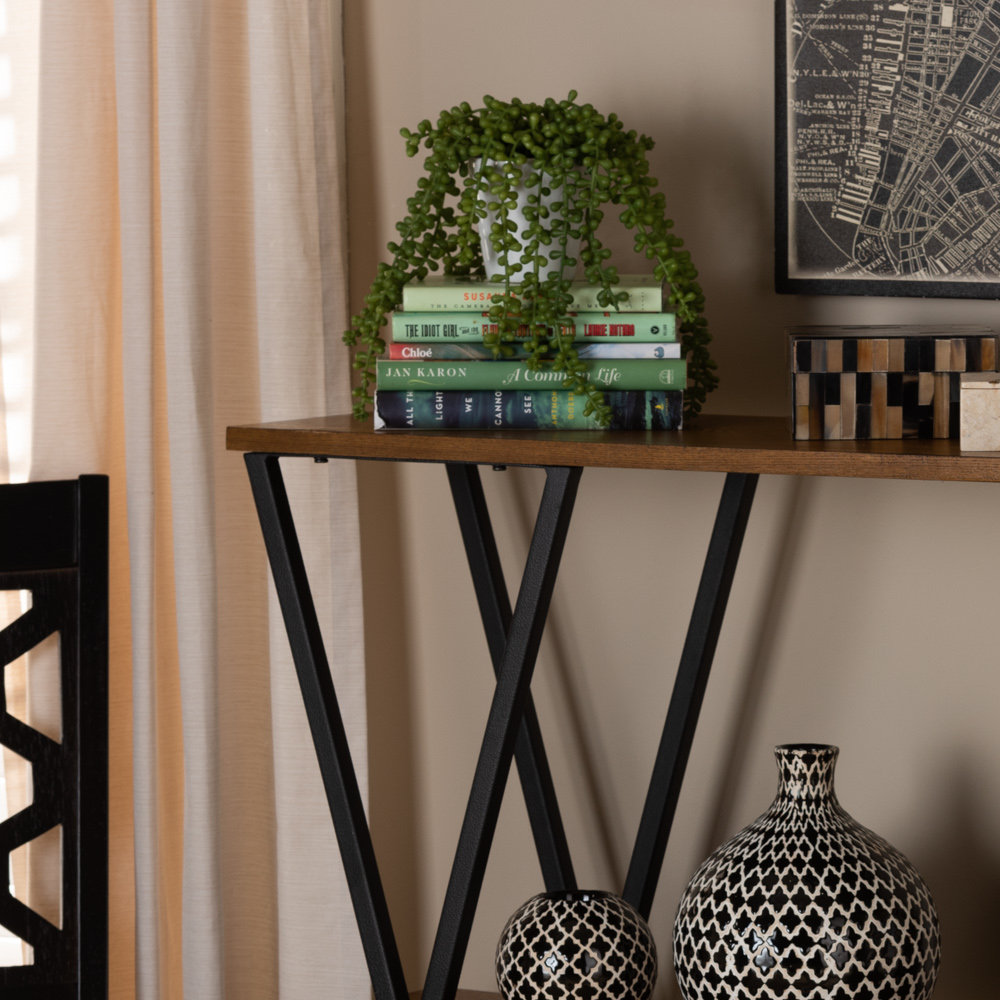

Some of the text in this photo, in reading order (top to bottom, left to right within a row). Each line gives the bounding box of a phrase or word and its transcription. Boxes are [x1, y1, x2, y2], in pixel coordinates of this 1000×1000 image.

[404, 324, 419, 338] THE
[421, 324, 440, 337] IDIOT
[443, 324, 459, 338] GIRL
[402, 347, 433, 359] Chloé
[385, 367, 468, 378] JAN KARON
[523, 369, 591, 382] Commn
[597, 368, 623, 387] Life
[465, 397, 473, 413] WE
[495, 391, 503, 426] CANNO
[524, 395, 532, 414] SEE
[406, 407, 414, 426] ALL
